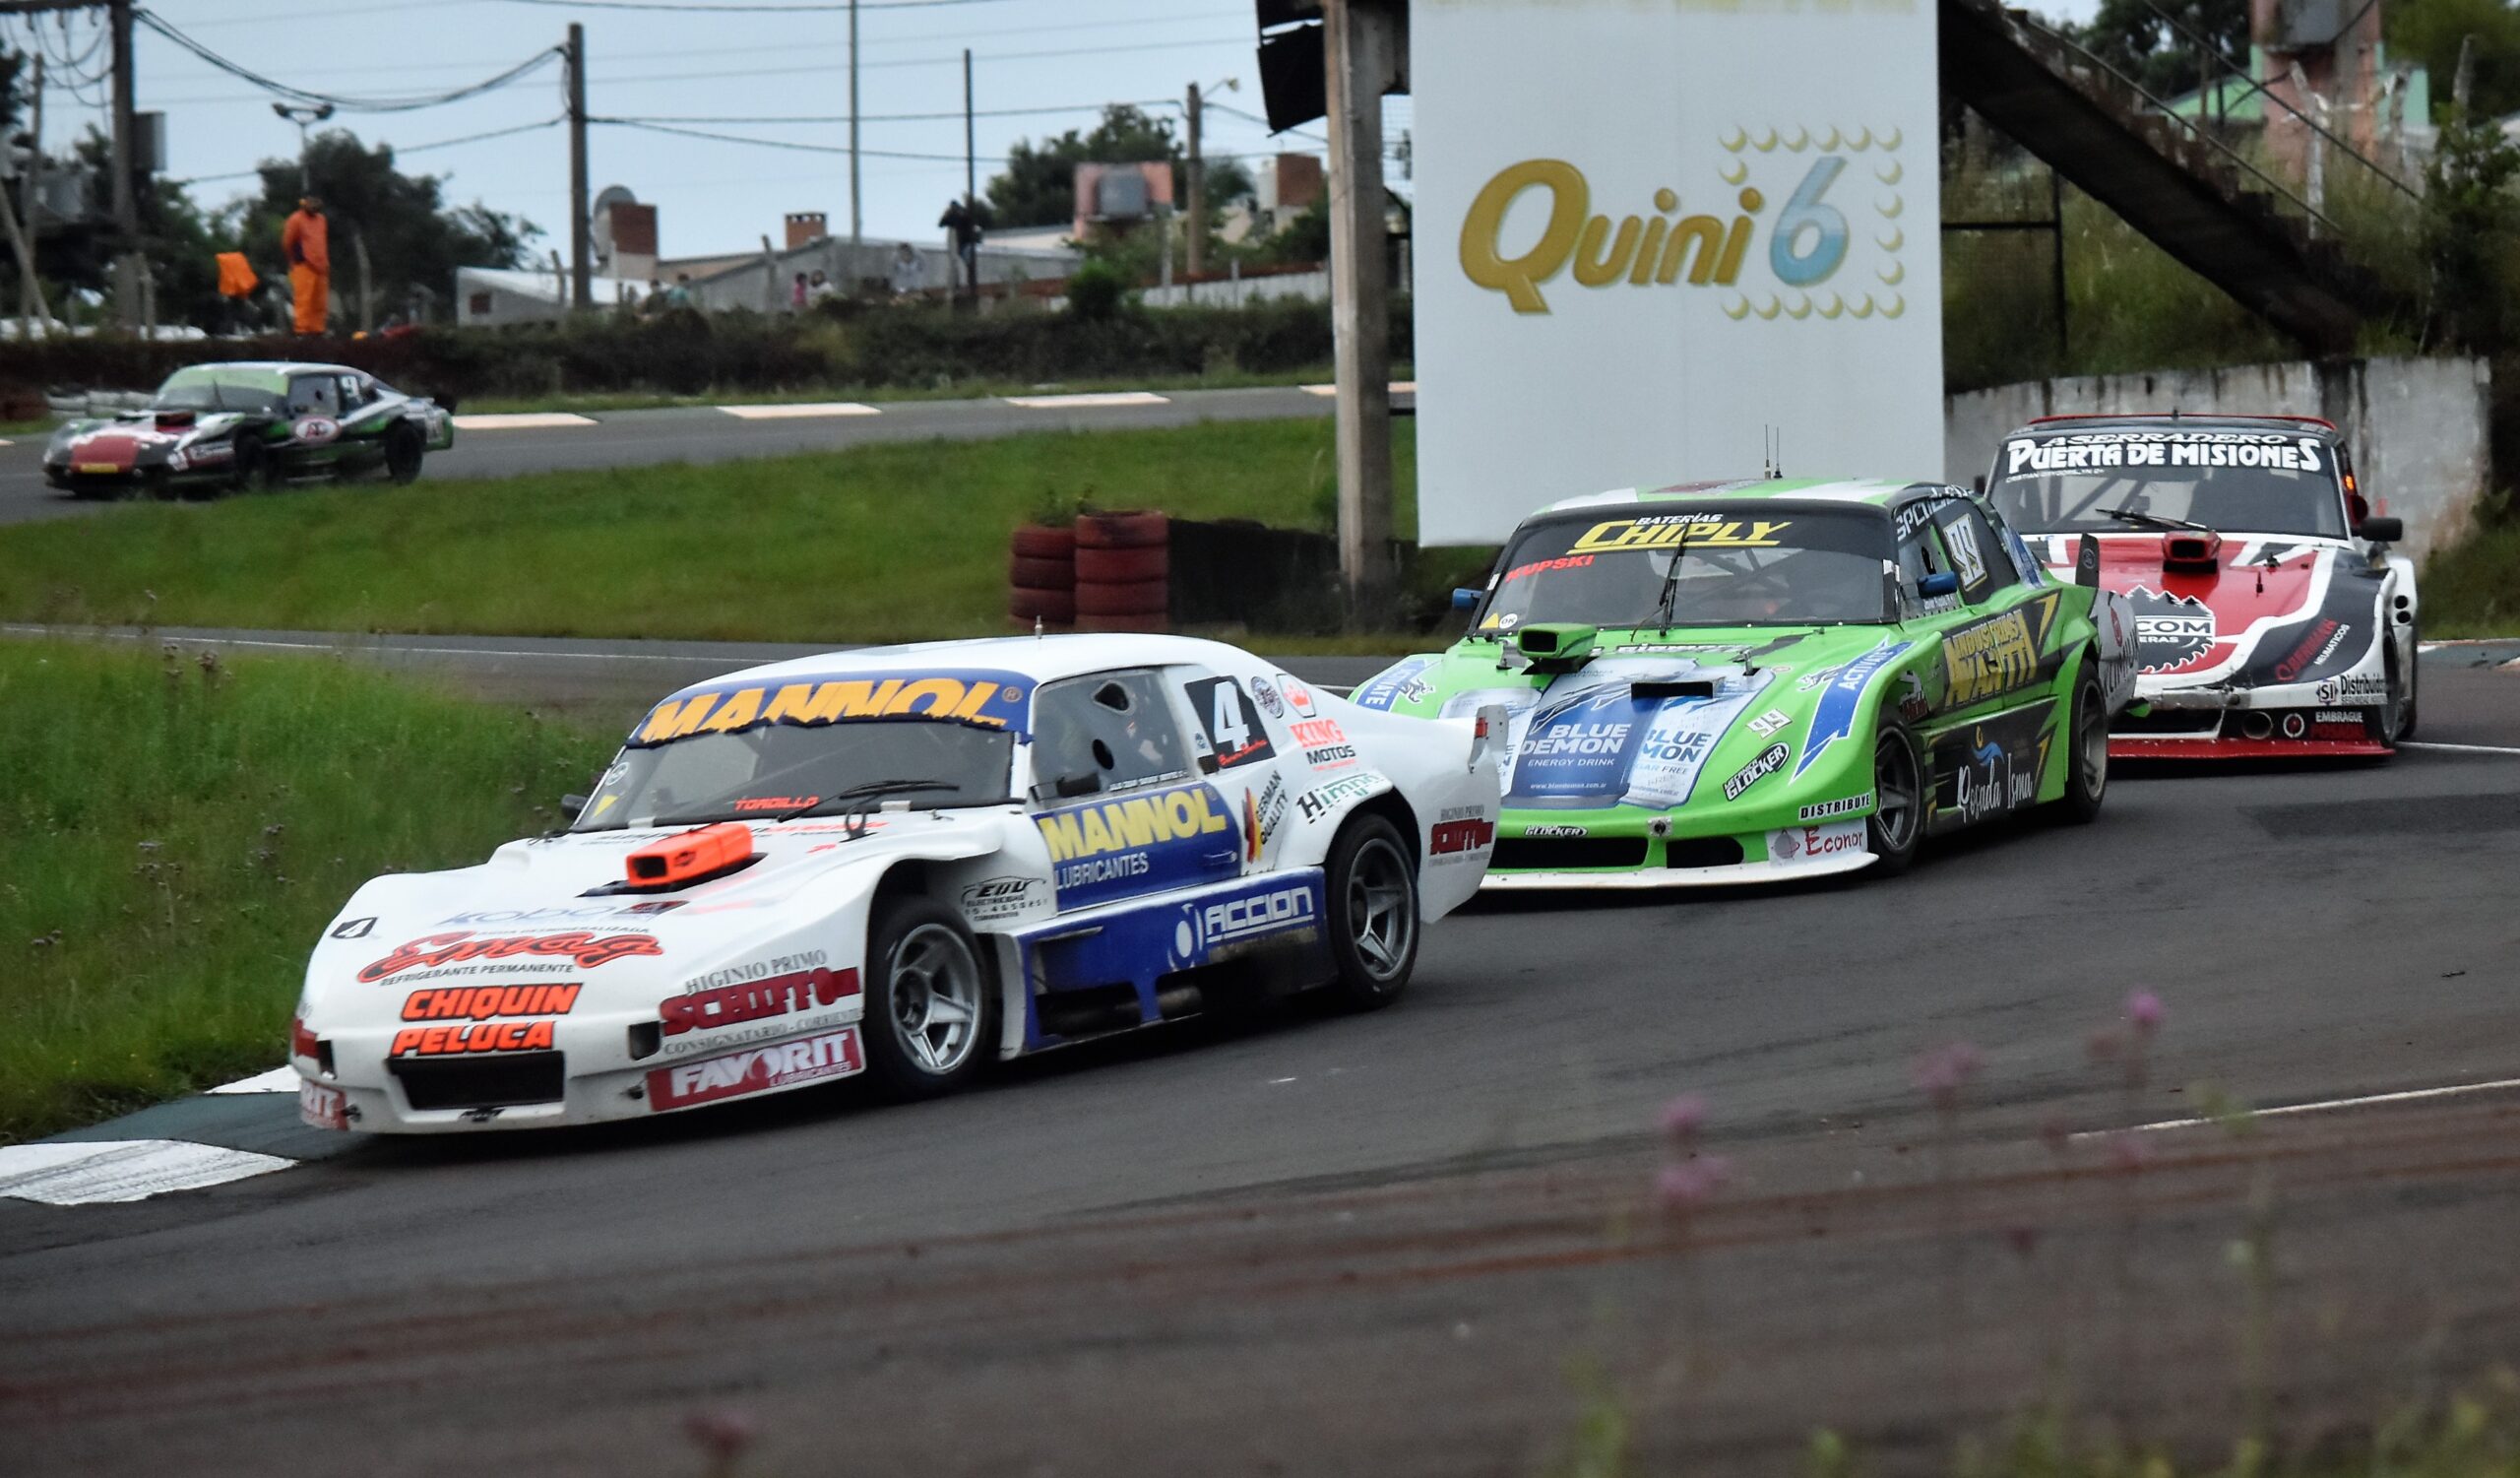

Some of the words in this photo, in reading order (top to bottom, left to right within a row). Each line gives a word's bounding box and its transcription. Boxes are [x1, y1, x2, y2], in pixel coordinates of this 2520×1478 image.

[1459, 159, 1764, 315] Quini
[1769, 156, 1850, 287] 6
[2008, 439, 2122, 474] PUERTA
[2127, 443, 2166, 466] DE
[2172, 438, 2320, 472] MISIONES
[2042, 433, 2288, 447] ASERRADERO
[1575, 520, 1793, 549] CHIPLY
[639, 677, 1007, 743] MANNOL
[1214, 680, 1250, 751] 4
[2315, 711, 2363, 723] EMBRAGUE
[1290, 719, 1347, 748] KING
[1520, 739, 1624, 755] DEMON
[1547, 724, 1631, 739] BLUE
[1306, 744, 1356, 765] MOTOS
[1528, 758, 1575, 768] ENERGY
[1580, 757, 1615, 767] DRINK
[1727, 745, 1785, 801] GLOCKER
[1255, 769, 1283, 823] GERMAN
[1800, 794, 1869, 819] DISTRIBUYE
[1037, 787, 1228, 864] MANNOL
[1260, 789, 1289, 846] QUALITY
[1053, 851, 1150, 890] LUBRICANTES
[1205, 885, 1314, 936] ACCION
[480, 963, 575, 974] PERMANENTE
[685, 961, 768, 995] HIGINIO
[771, 948, 828, 975] PRIMO
[401, 983, 584, 1022] CHIQUIN
[391, 1021, 555, 1057] PELUCA
[670, 1032, 850, 1098] FAVORIT
